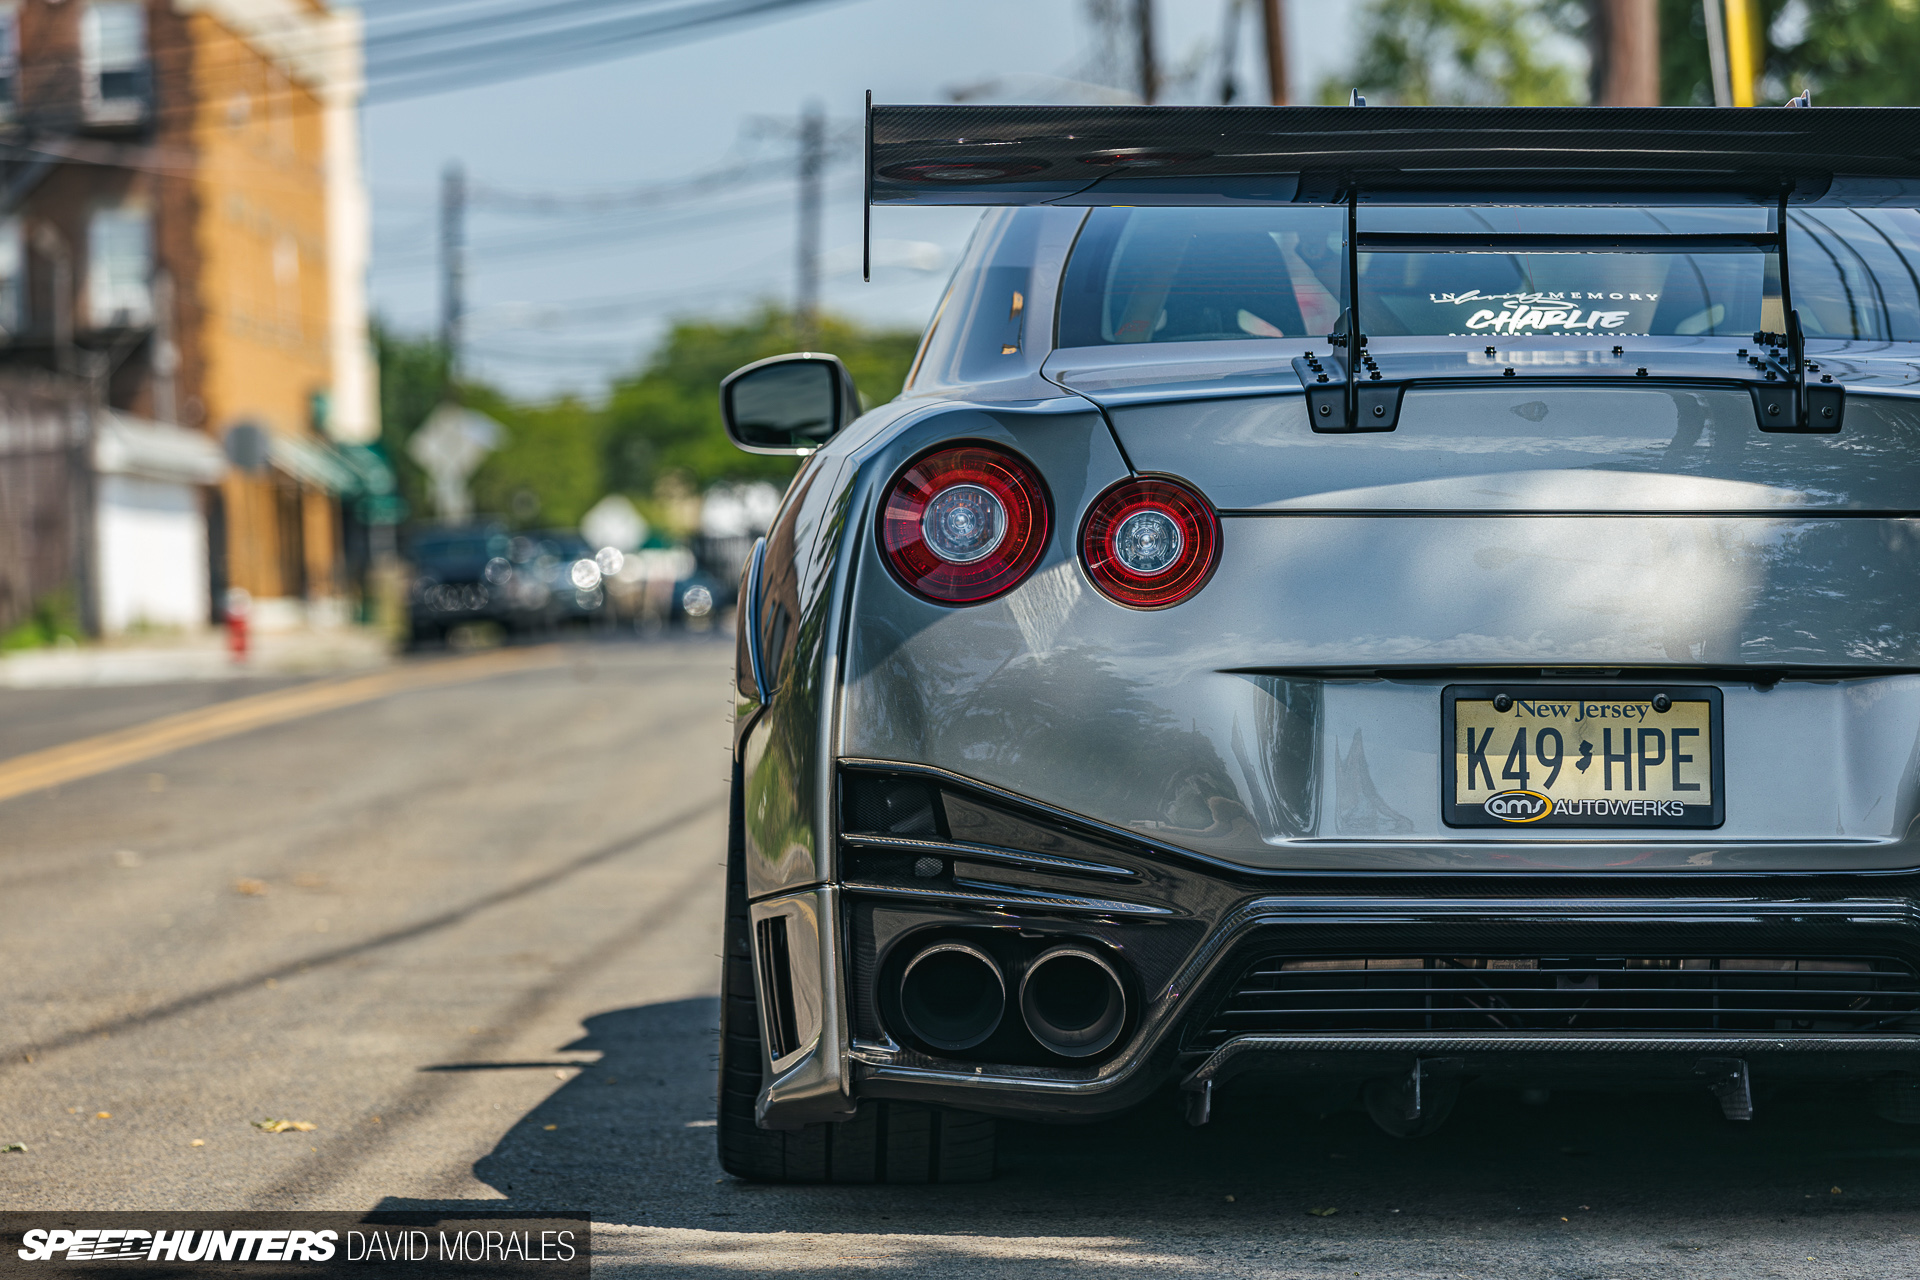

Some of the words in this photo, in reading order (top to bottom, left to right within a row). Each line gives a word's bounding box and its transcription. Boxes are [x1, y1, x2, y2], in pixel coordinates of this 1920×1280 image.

[1549, 292, 1659, 301] MEMORY
[1466, 305, 1630, 335] CHARLIE
[1514, 700, 1572, 718] New
[1574, 700, 1650, 723] Jersey
[1467, 727, 1564, 791] K49
[1603, 727, 1701, 791] HPE
[1553, 799, 1685, 817] AUTOWERKS
